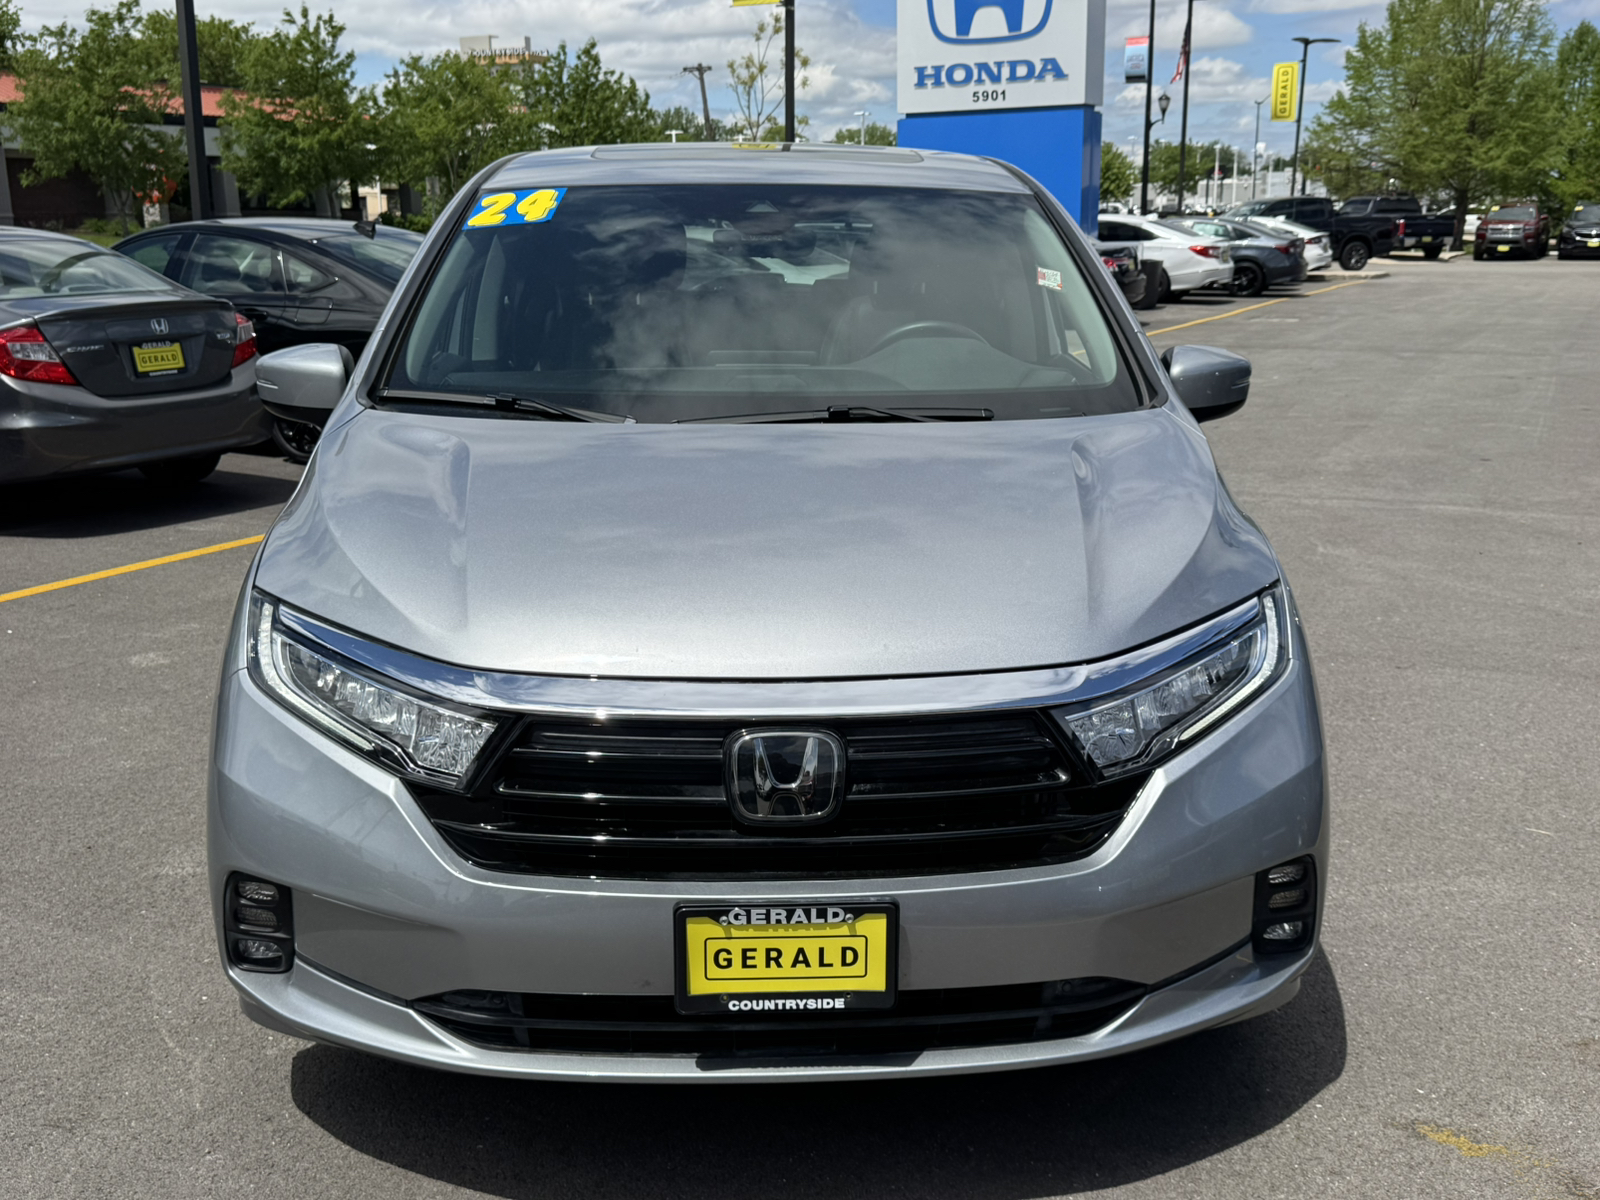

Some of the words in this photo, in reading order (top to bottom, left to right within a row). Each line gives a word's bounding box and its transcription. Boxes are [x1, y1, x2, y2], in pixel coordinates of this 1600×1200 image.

[914, 57, 1069, 89] HONDA
[972, 89, 1007, 103] 5901
[1279, 70, 1290, 115] GERALD
[467, 188, 559, 226] 24
[141, 340, 171, 349] GERALD
[141, 353, 178, 364] GERALD
[728, 907, 846, 925] GERALD
[713, 946, 860, 970] GERALD
[728, 998, 846, 1011] COUNTRYSIDE
